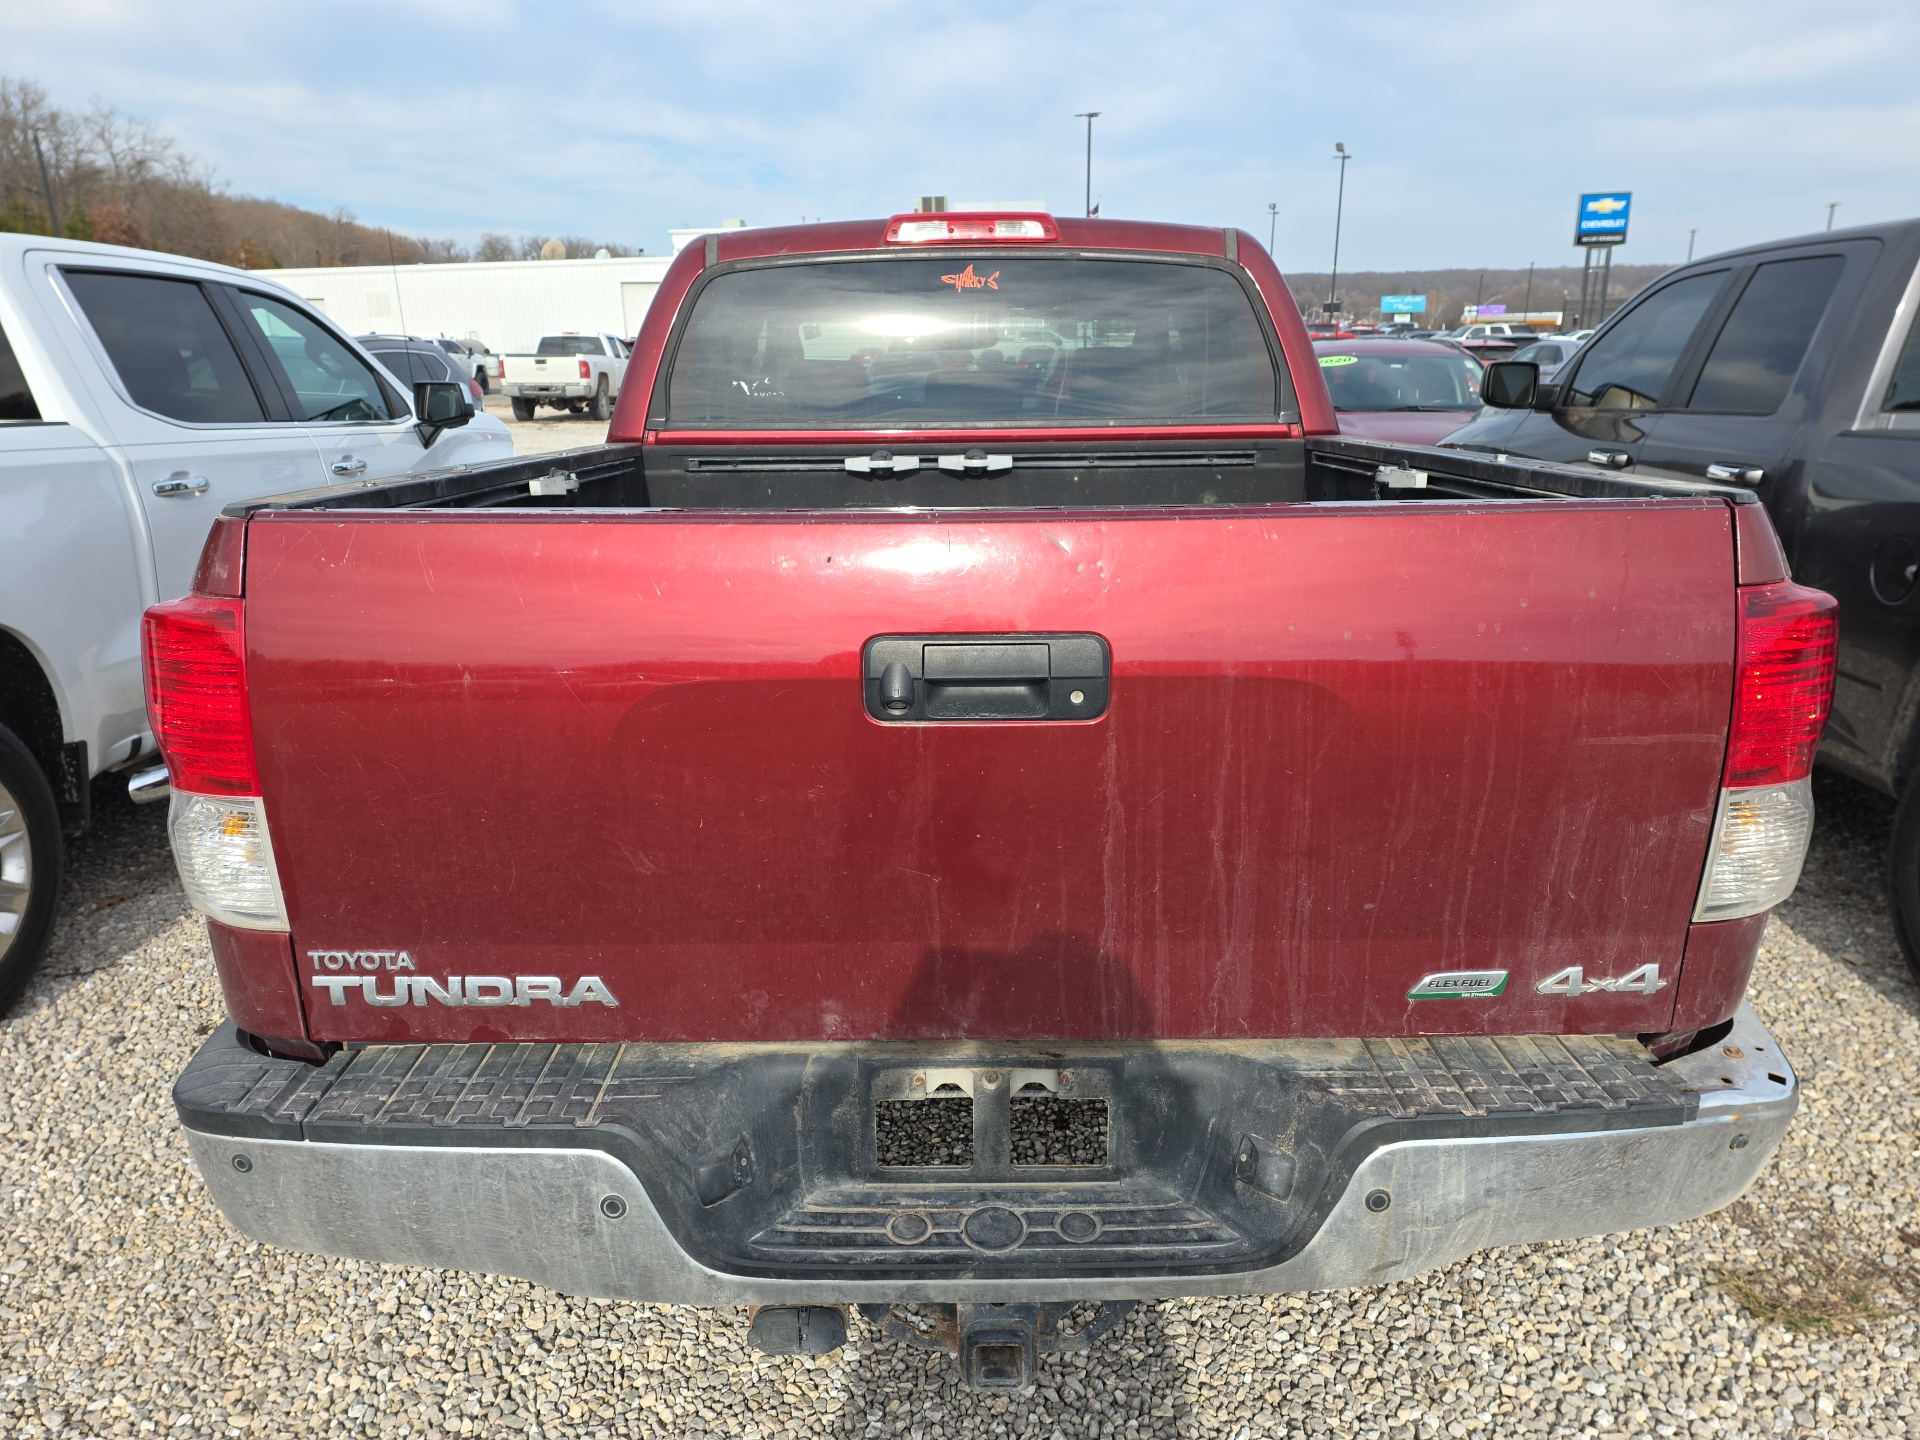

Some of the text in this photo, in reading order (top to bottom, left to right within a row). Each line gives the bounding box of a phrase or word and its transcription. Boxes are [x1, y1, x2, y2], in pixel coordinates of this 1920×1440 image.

[1580, 218, 1626, 229] CHEVROLET
[307, 950, 416, 971] TOYOTA
[311, 975, 621, 1008] TUNDRA
[1536, 963, 1668, 997] 4x4
